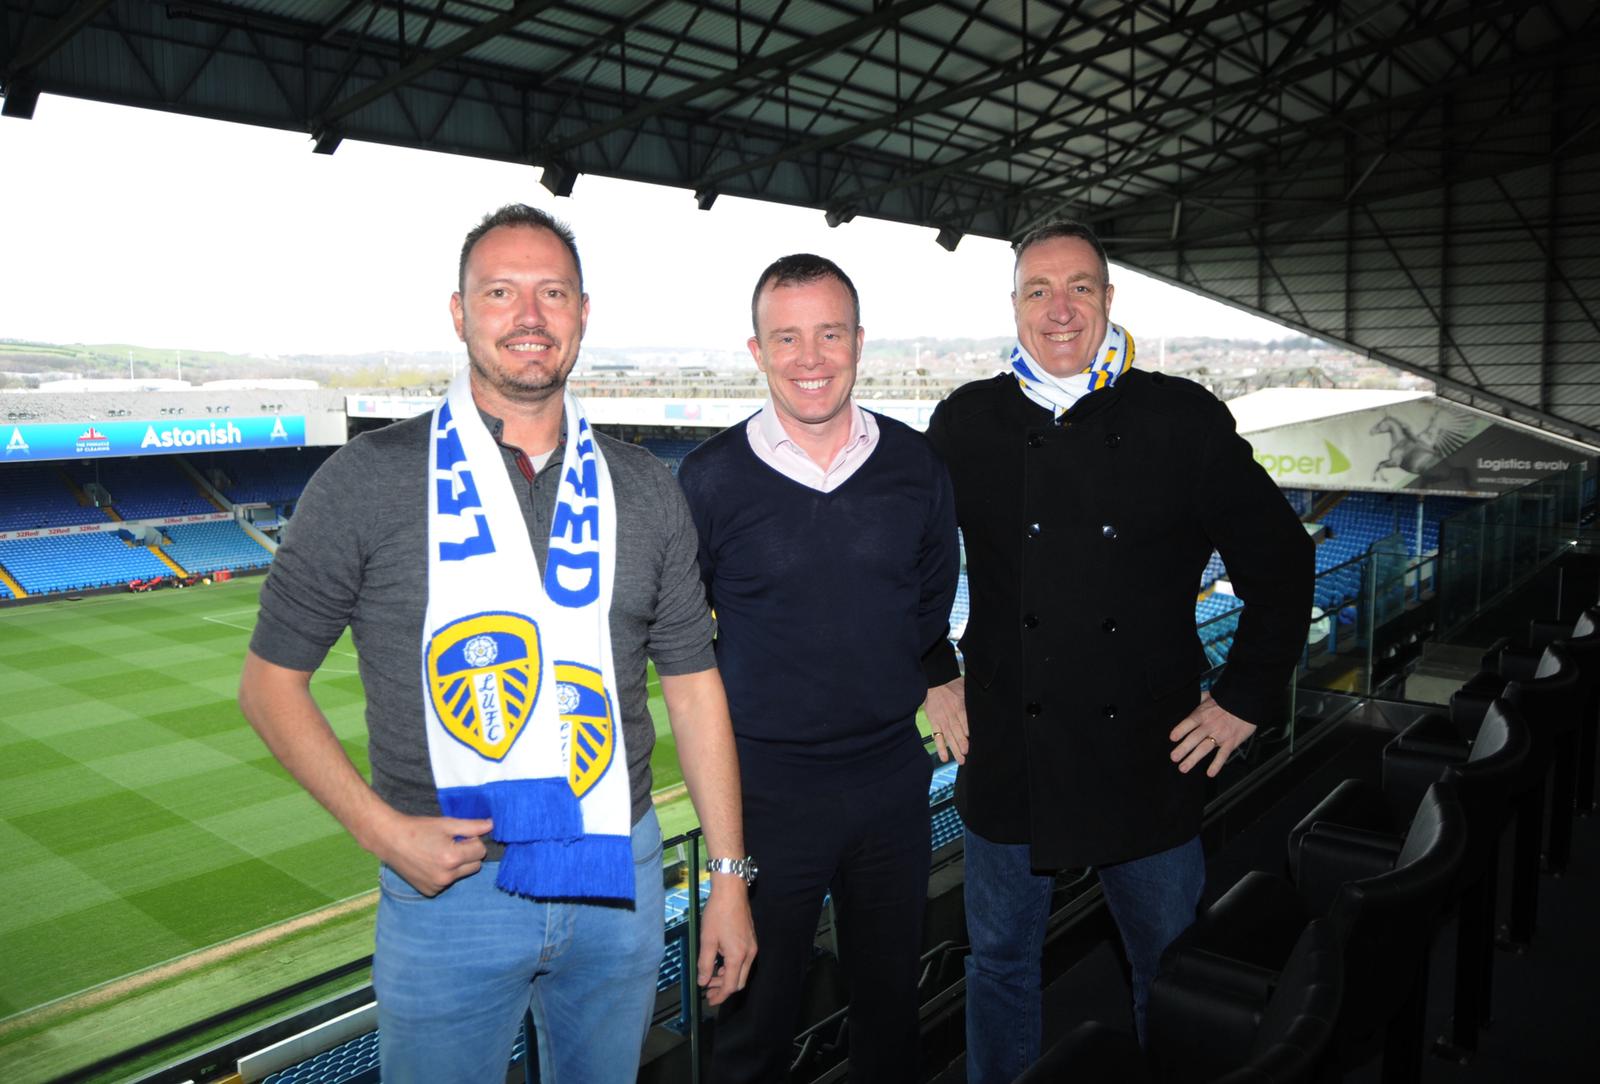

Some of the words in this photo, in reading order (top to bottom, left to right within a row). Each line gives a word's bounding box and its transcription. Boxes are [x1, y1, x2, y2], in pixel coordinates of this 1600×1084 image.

[141, 421, 242, 449] Astonish
[1254, 447, 1325, 477] ipper
[1477, 457, 1531, 472] Logistics
[437, 399, 496, 561] LEE
